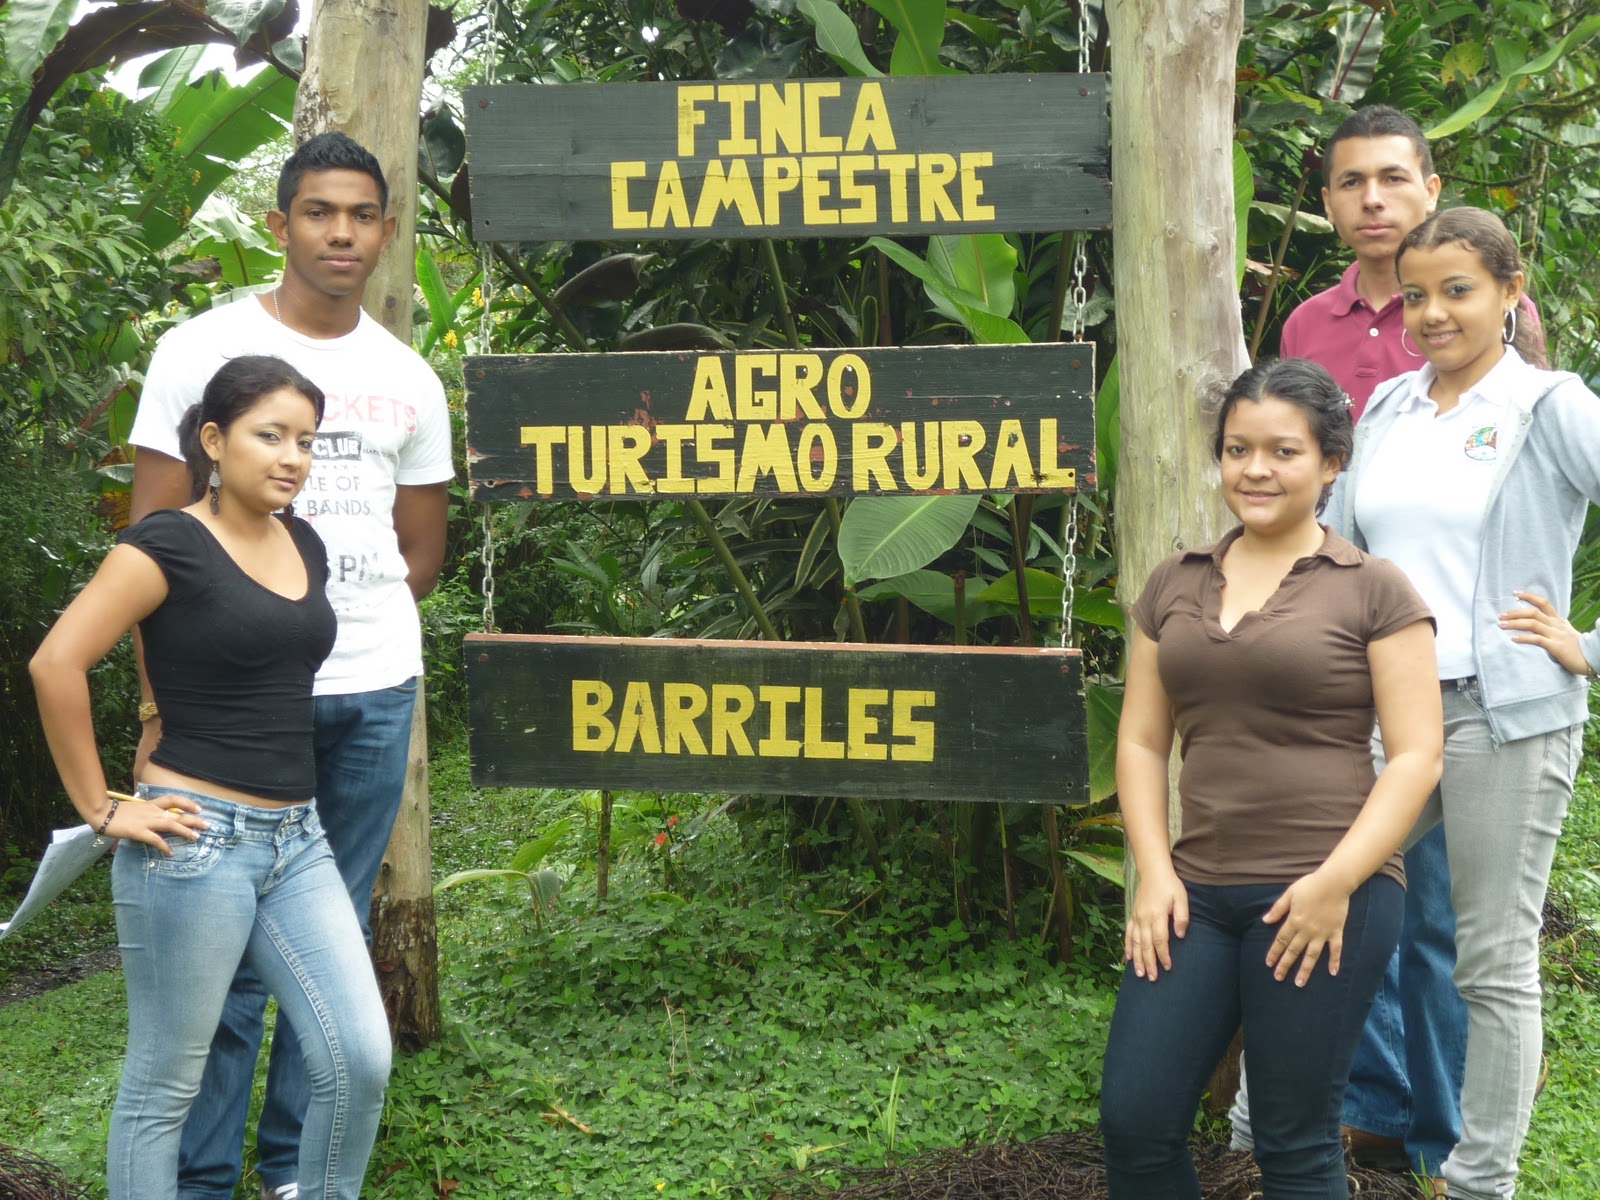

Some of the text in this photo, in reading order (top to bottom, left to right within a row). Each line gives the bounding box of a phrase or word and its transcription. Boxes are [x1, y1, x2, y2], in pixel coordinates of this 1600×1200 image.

[677, 82, 897, 157] FINCA
[609, 151, 996, 230] CAMPESTRE
[685, 353, 872, 421] AGRO
[312, 437, 359, 458] CLUB
[520, 418, 1077, 495] TURISMO RURAL
[307, 499, 371, 516] BANDS
[336, 476, 361, 491] OF
[338, 552, 385, 583] PM
[572, 680, 936, 762] BARRILES
